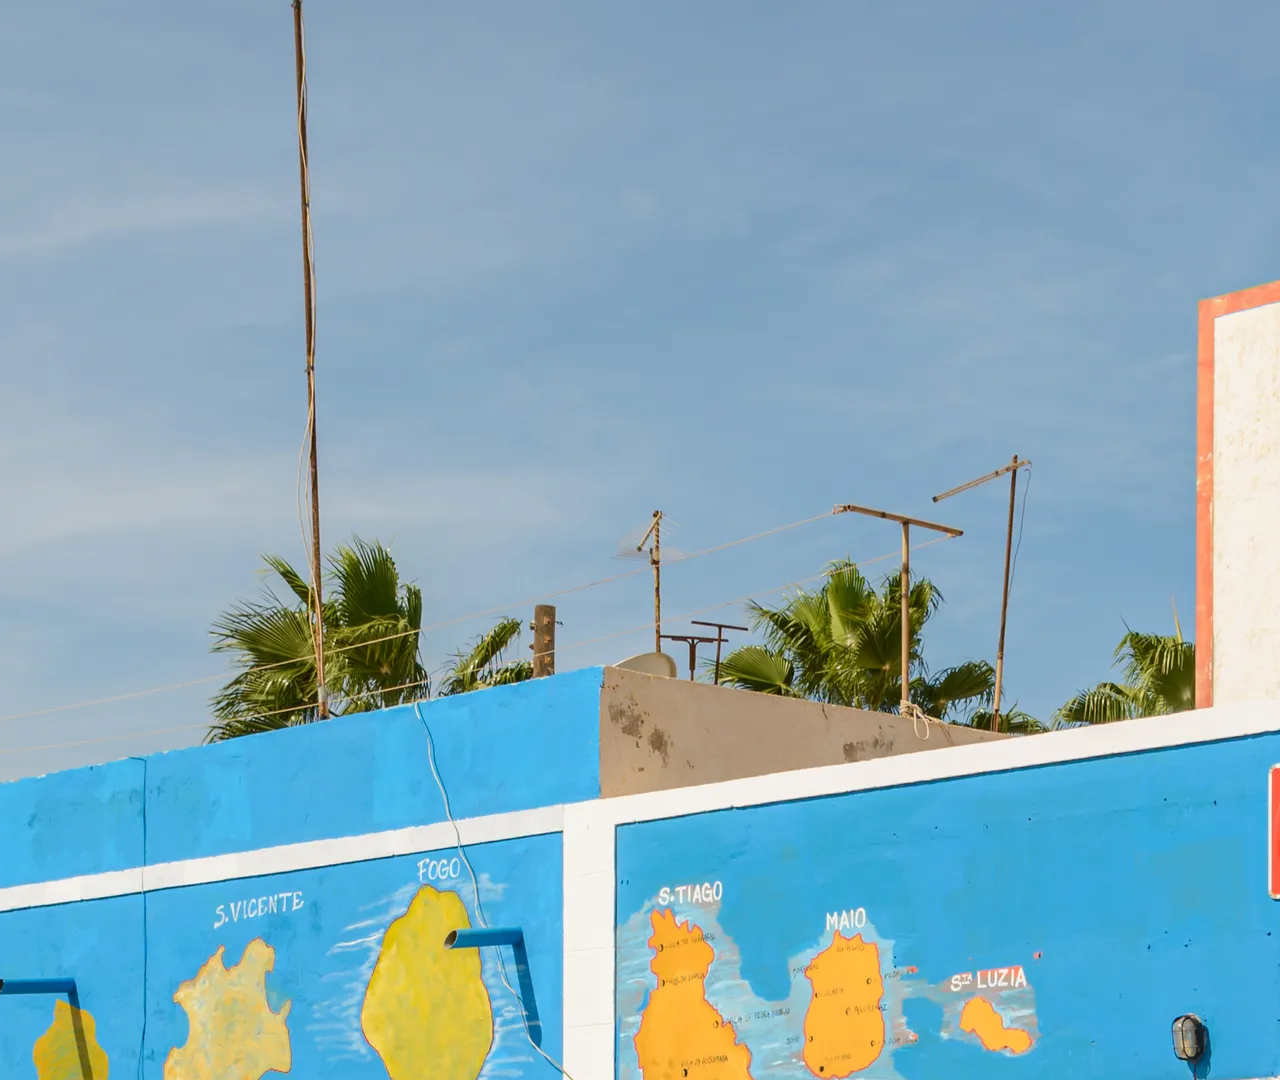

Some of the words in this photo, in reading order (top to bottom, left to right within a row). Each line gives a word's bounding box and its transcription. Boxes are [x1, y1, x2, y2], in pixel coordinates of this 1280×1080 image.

[417, 857, 461, 881] FOGO
[826, 907, 867, 931] MAIO
[976, 967, 1027, 989] LUZIA
